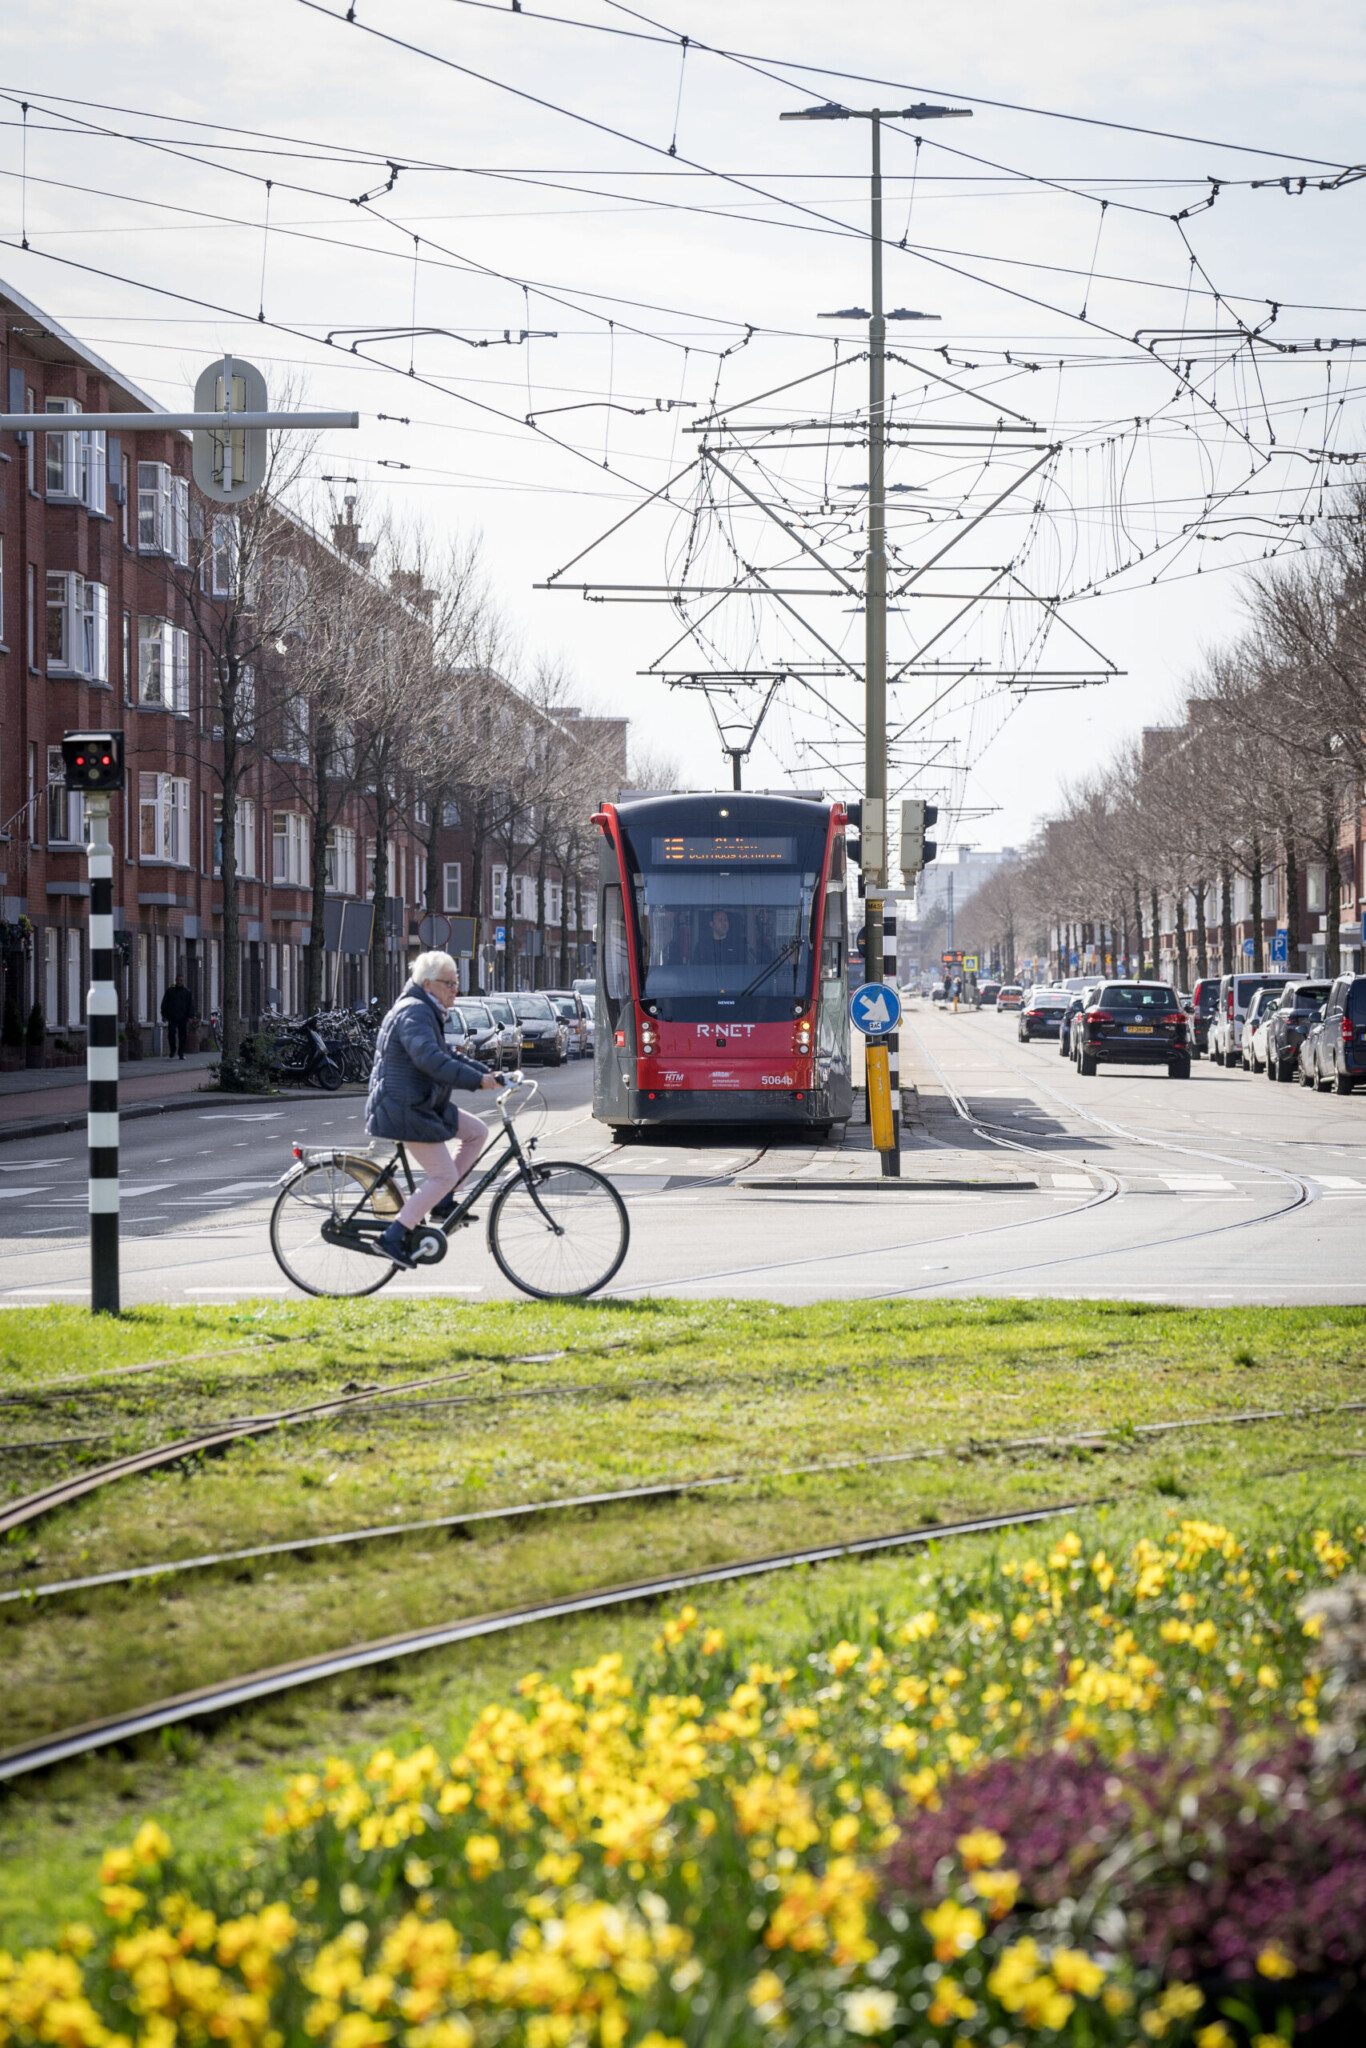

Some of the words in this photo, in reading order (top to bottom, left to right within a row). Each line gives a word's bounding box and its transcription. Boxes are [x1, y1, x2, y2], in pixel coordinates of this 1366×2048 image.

[497, 931, 504, 940] P
[1275, 939, 1283, 951] P
[665, 1073, 684, 1081] HTM
[761, 1075, 793, 1085] 5064b
